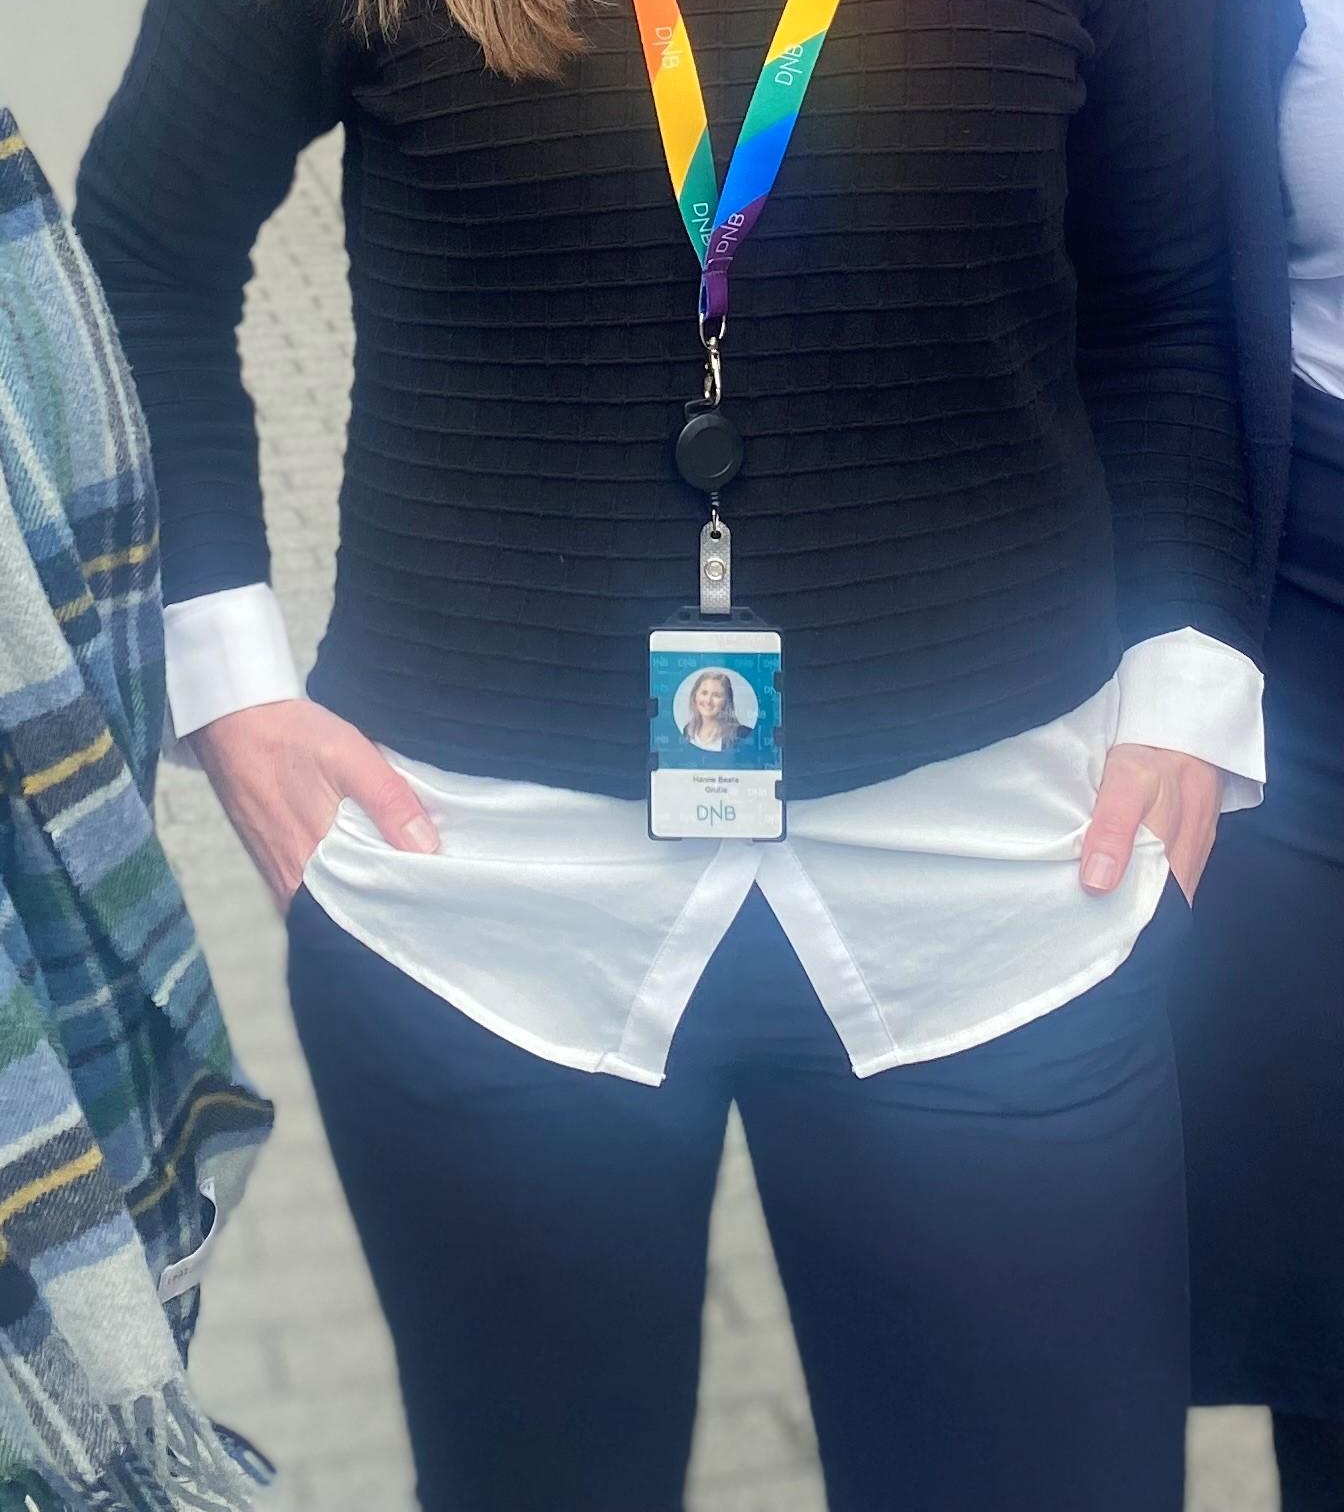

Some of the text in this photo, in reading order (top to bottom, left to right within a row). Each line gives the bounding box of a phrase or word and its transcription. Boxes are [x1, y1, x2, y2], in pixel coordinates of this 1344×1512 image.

[651, 26, 684, 69] DNB
[774, 44, 804, 86] DNB
[715, 212, 745, 253] DNB
[696, 799, 737, 826] DNB
